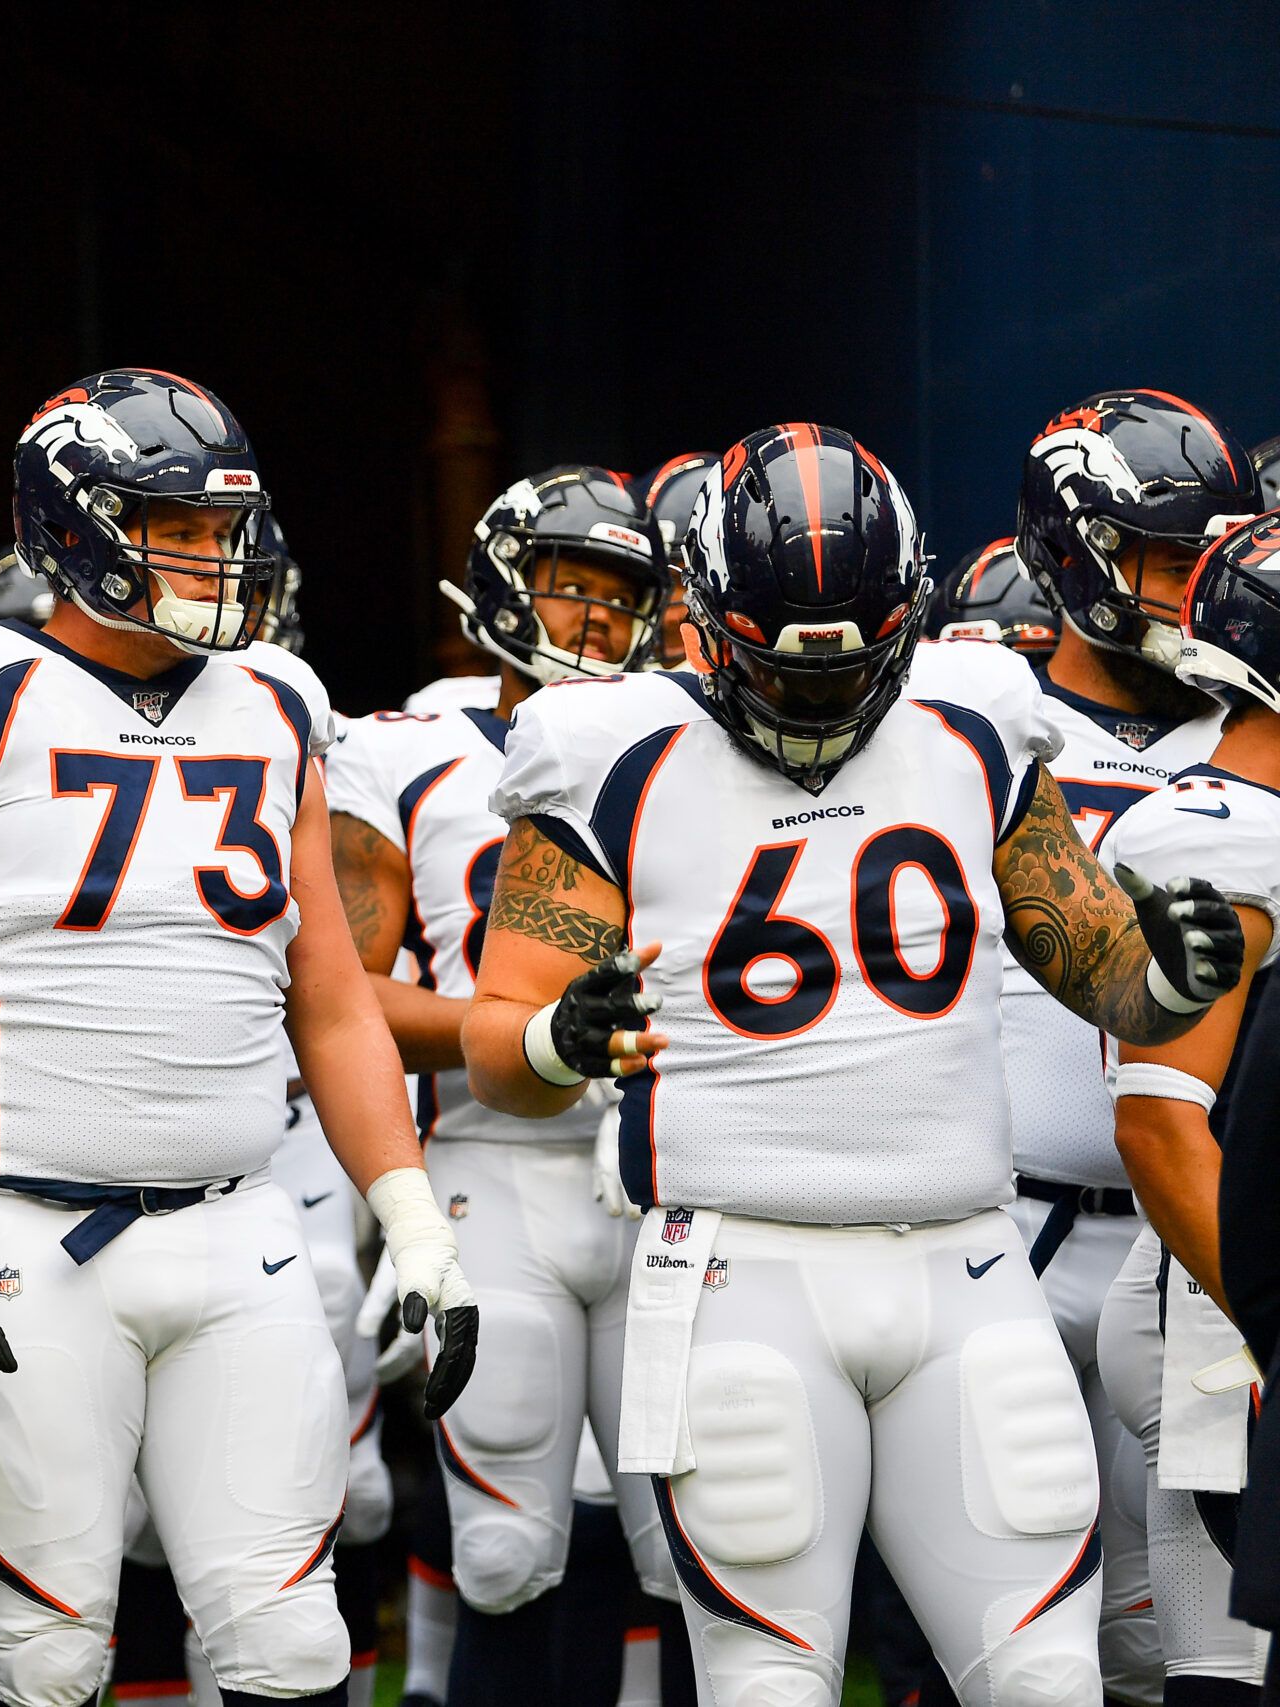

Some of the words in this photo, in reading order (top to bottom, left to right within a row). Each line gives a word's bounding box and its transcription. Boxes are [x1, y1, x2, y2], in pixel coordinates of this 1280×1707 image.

[224, 474, 253, 486] BRONCOS
[119, 733, 196, 746] BRONCOS
[772, 805, 865, 829] BRONCOS
[49, 748, 291, 937] 73
[702, 823, 979, 1041] 60
[664, 1223, 688, 1242] NFL
[646, 1254, 688, 1268] Wilson
[704, 1270, 725, 1284] NFL
[0, 1280, 18, 1293] NFL
